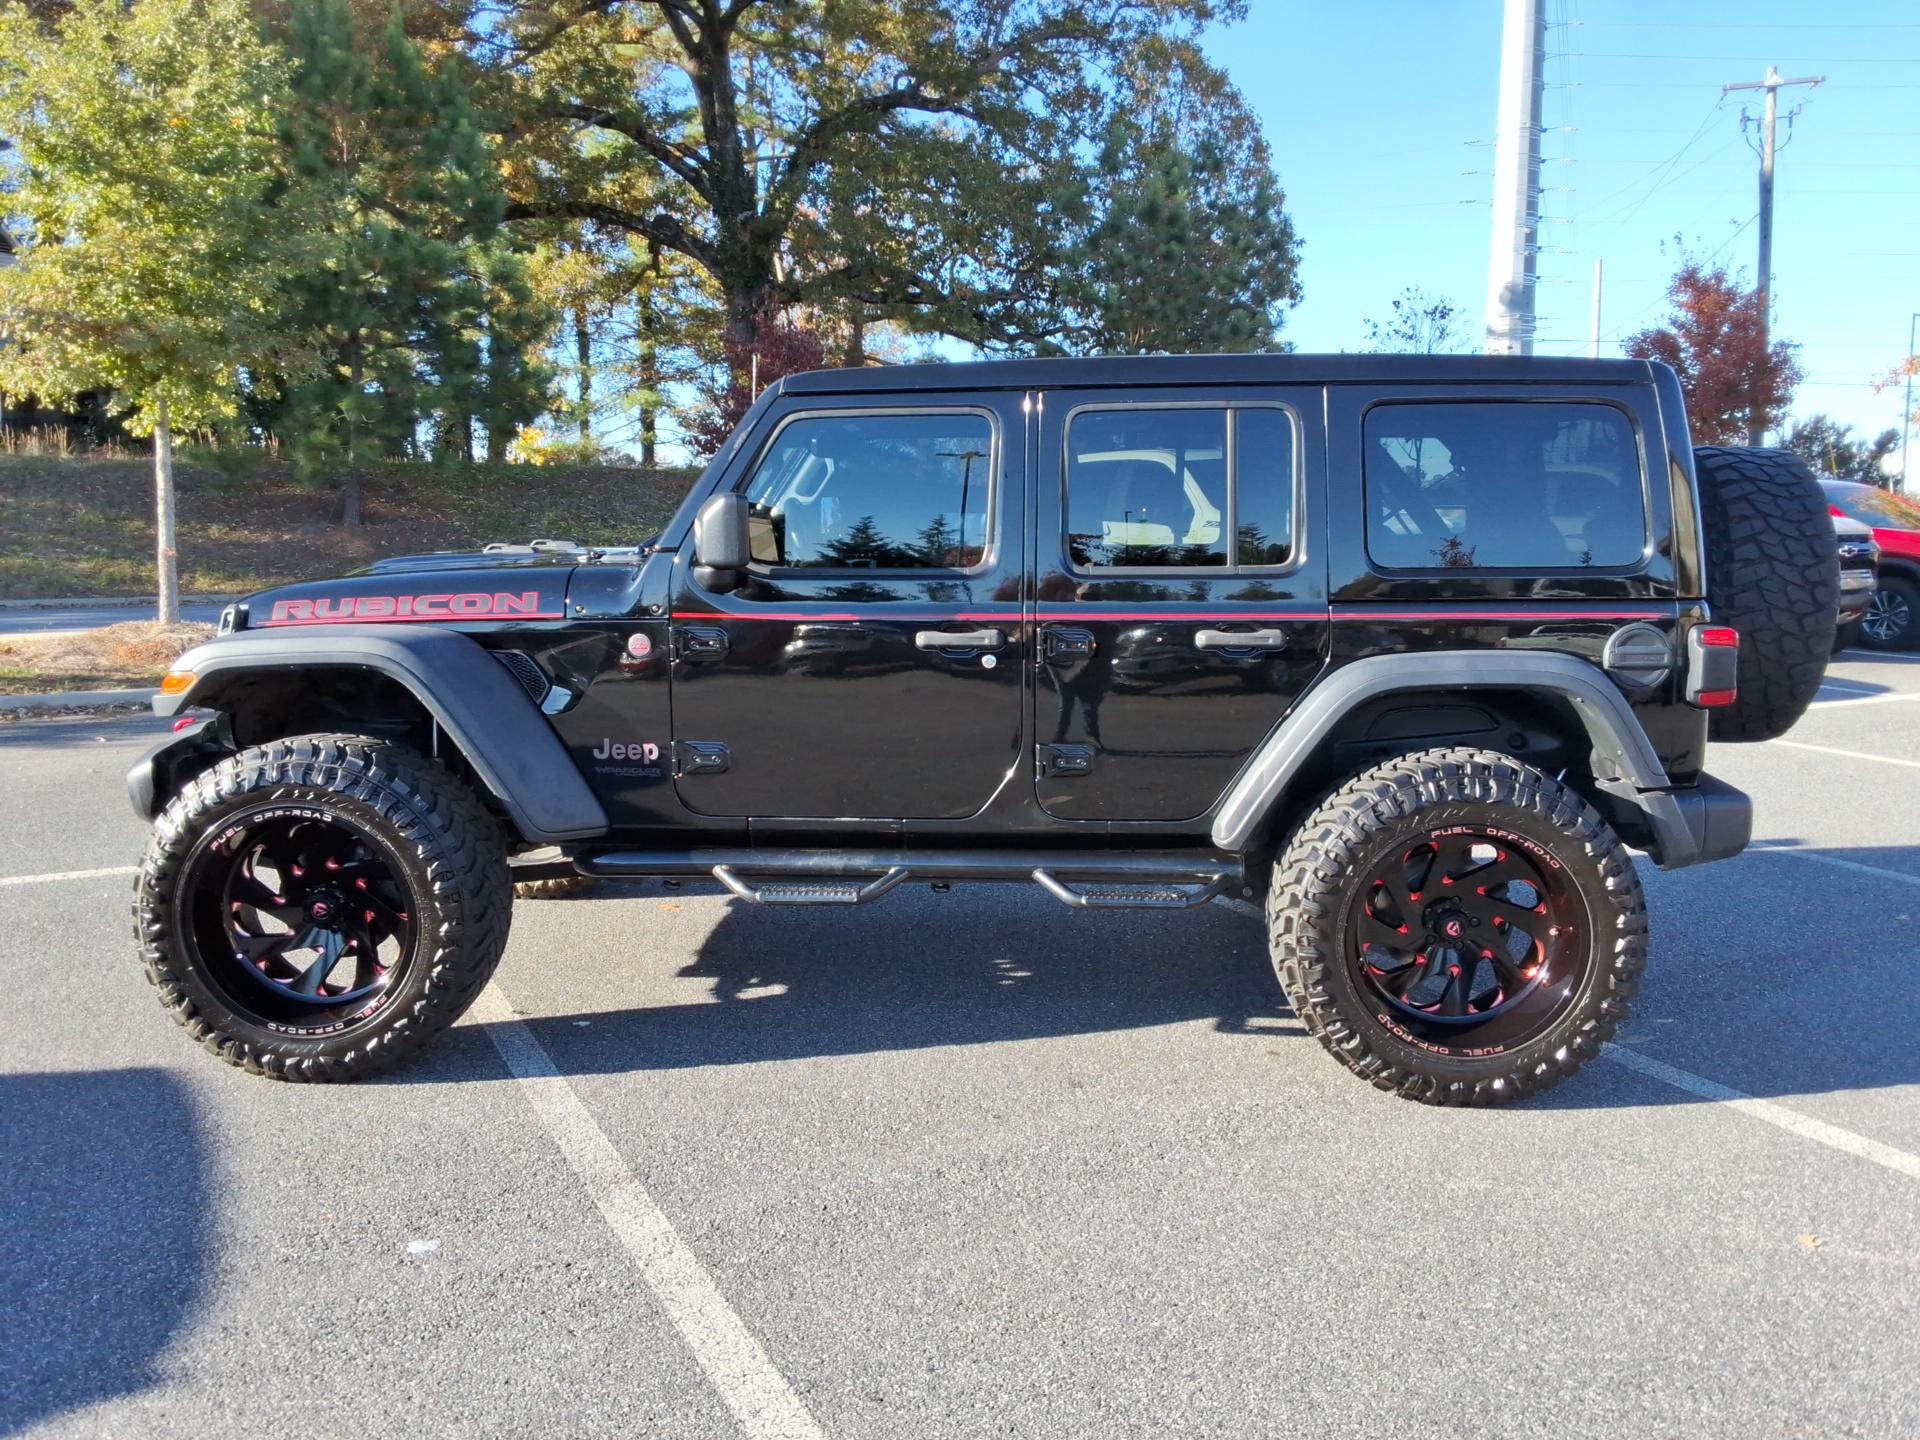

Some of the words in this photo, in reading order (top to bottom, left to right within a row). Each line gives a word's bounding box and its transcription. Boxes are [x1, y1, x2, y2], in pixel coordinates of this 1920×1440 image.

[271, 591, 539, 621] RUBICON
[593, 738, 659, 764] Jeep
[210, 825, 244, 851] FUEL
[253, 809, 333, 823] OFF-ROAD
[1430, 826, 1474, 839] FUEL
[1486, 827, 1561, 869] OFF-ROAD
[354, 994, 388, 1019] FUEL
[267, 1022, 345, 1035] OFF-ROAD
[1377, 1013, 1449, 1056] OFF-ROAD
[1462, 1044, 1505, 1057] FUEL
